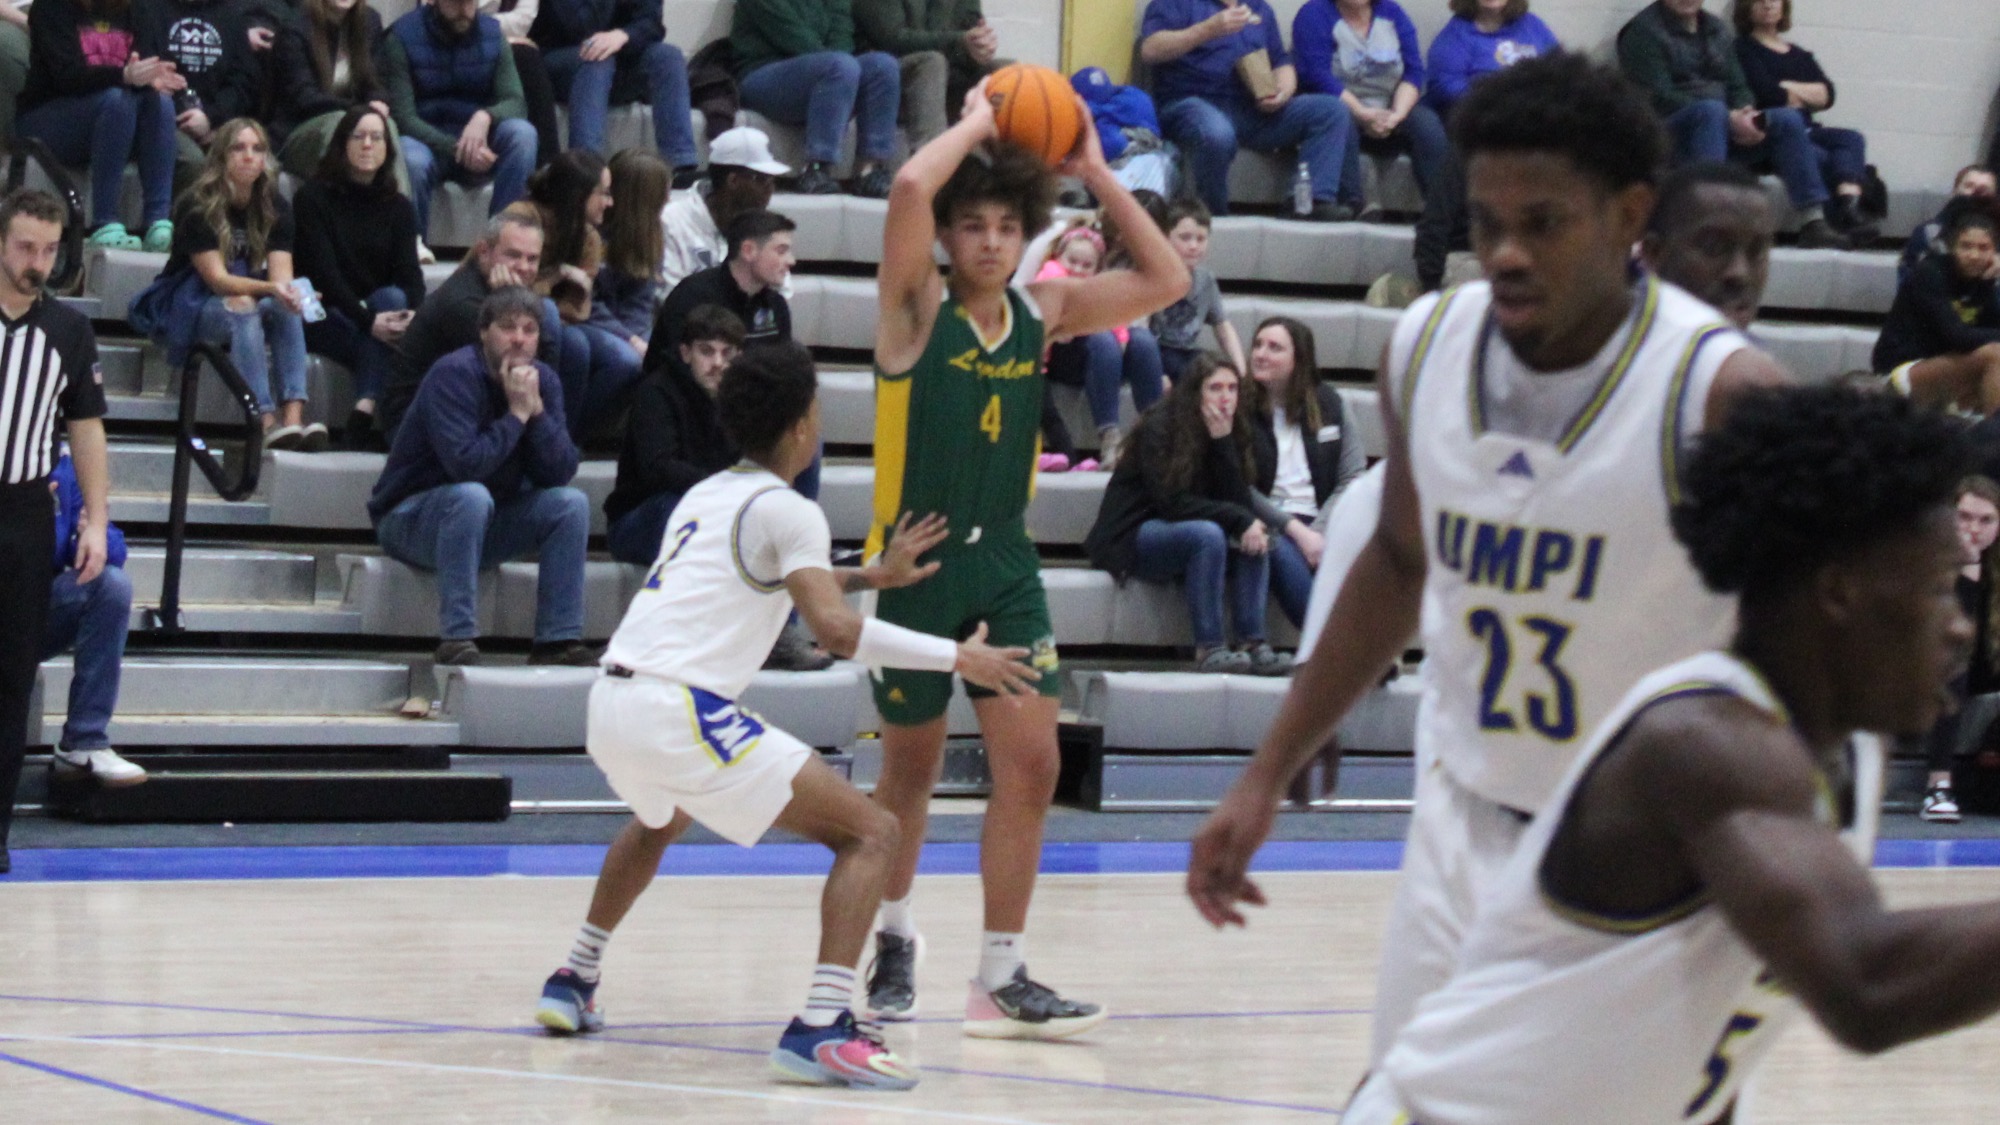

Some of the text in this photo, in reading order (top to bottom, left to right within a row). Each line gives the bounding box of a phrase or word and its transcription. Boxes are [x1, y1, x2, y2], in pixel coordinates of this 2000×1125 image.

[980, 393, 1003, 443] 4
[1435, 509, 1605, 602] UMPI
[1464, 604, 1579, 742] 23
[1682, 1010, 1765, 1119] 5
